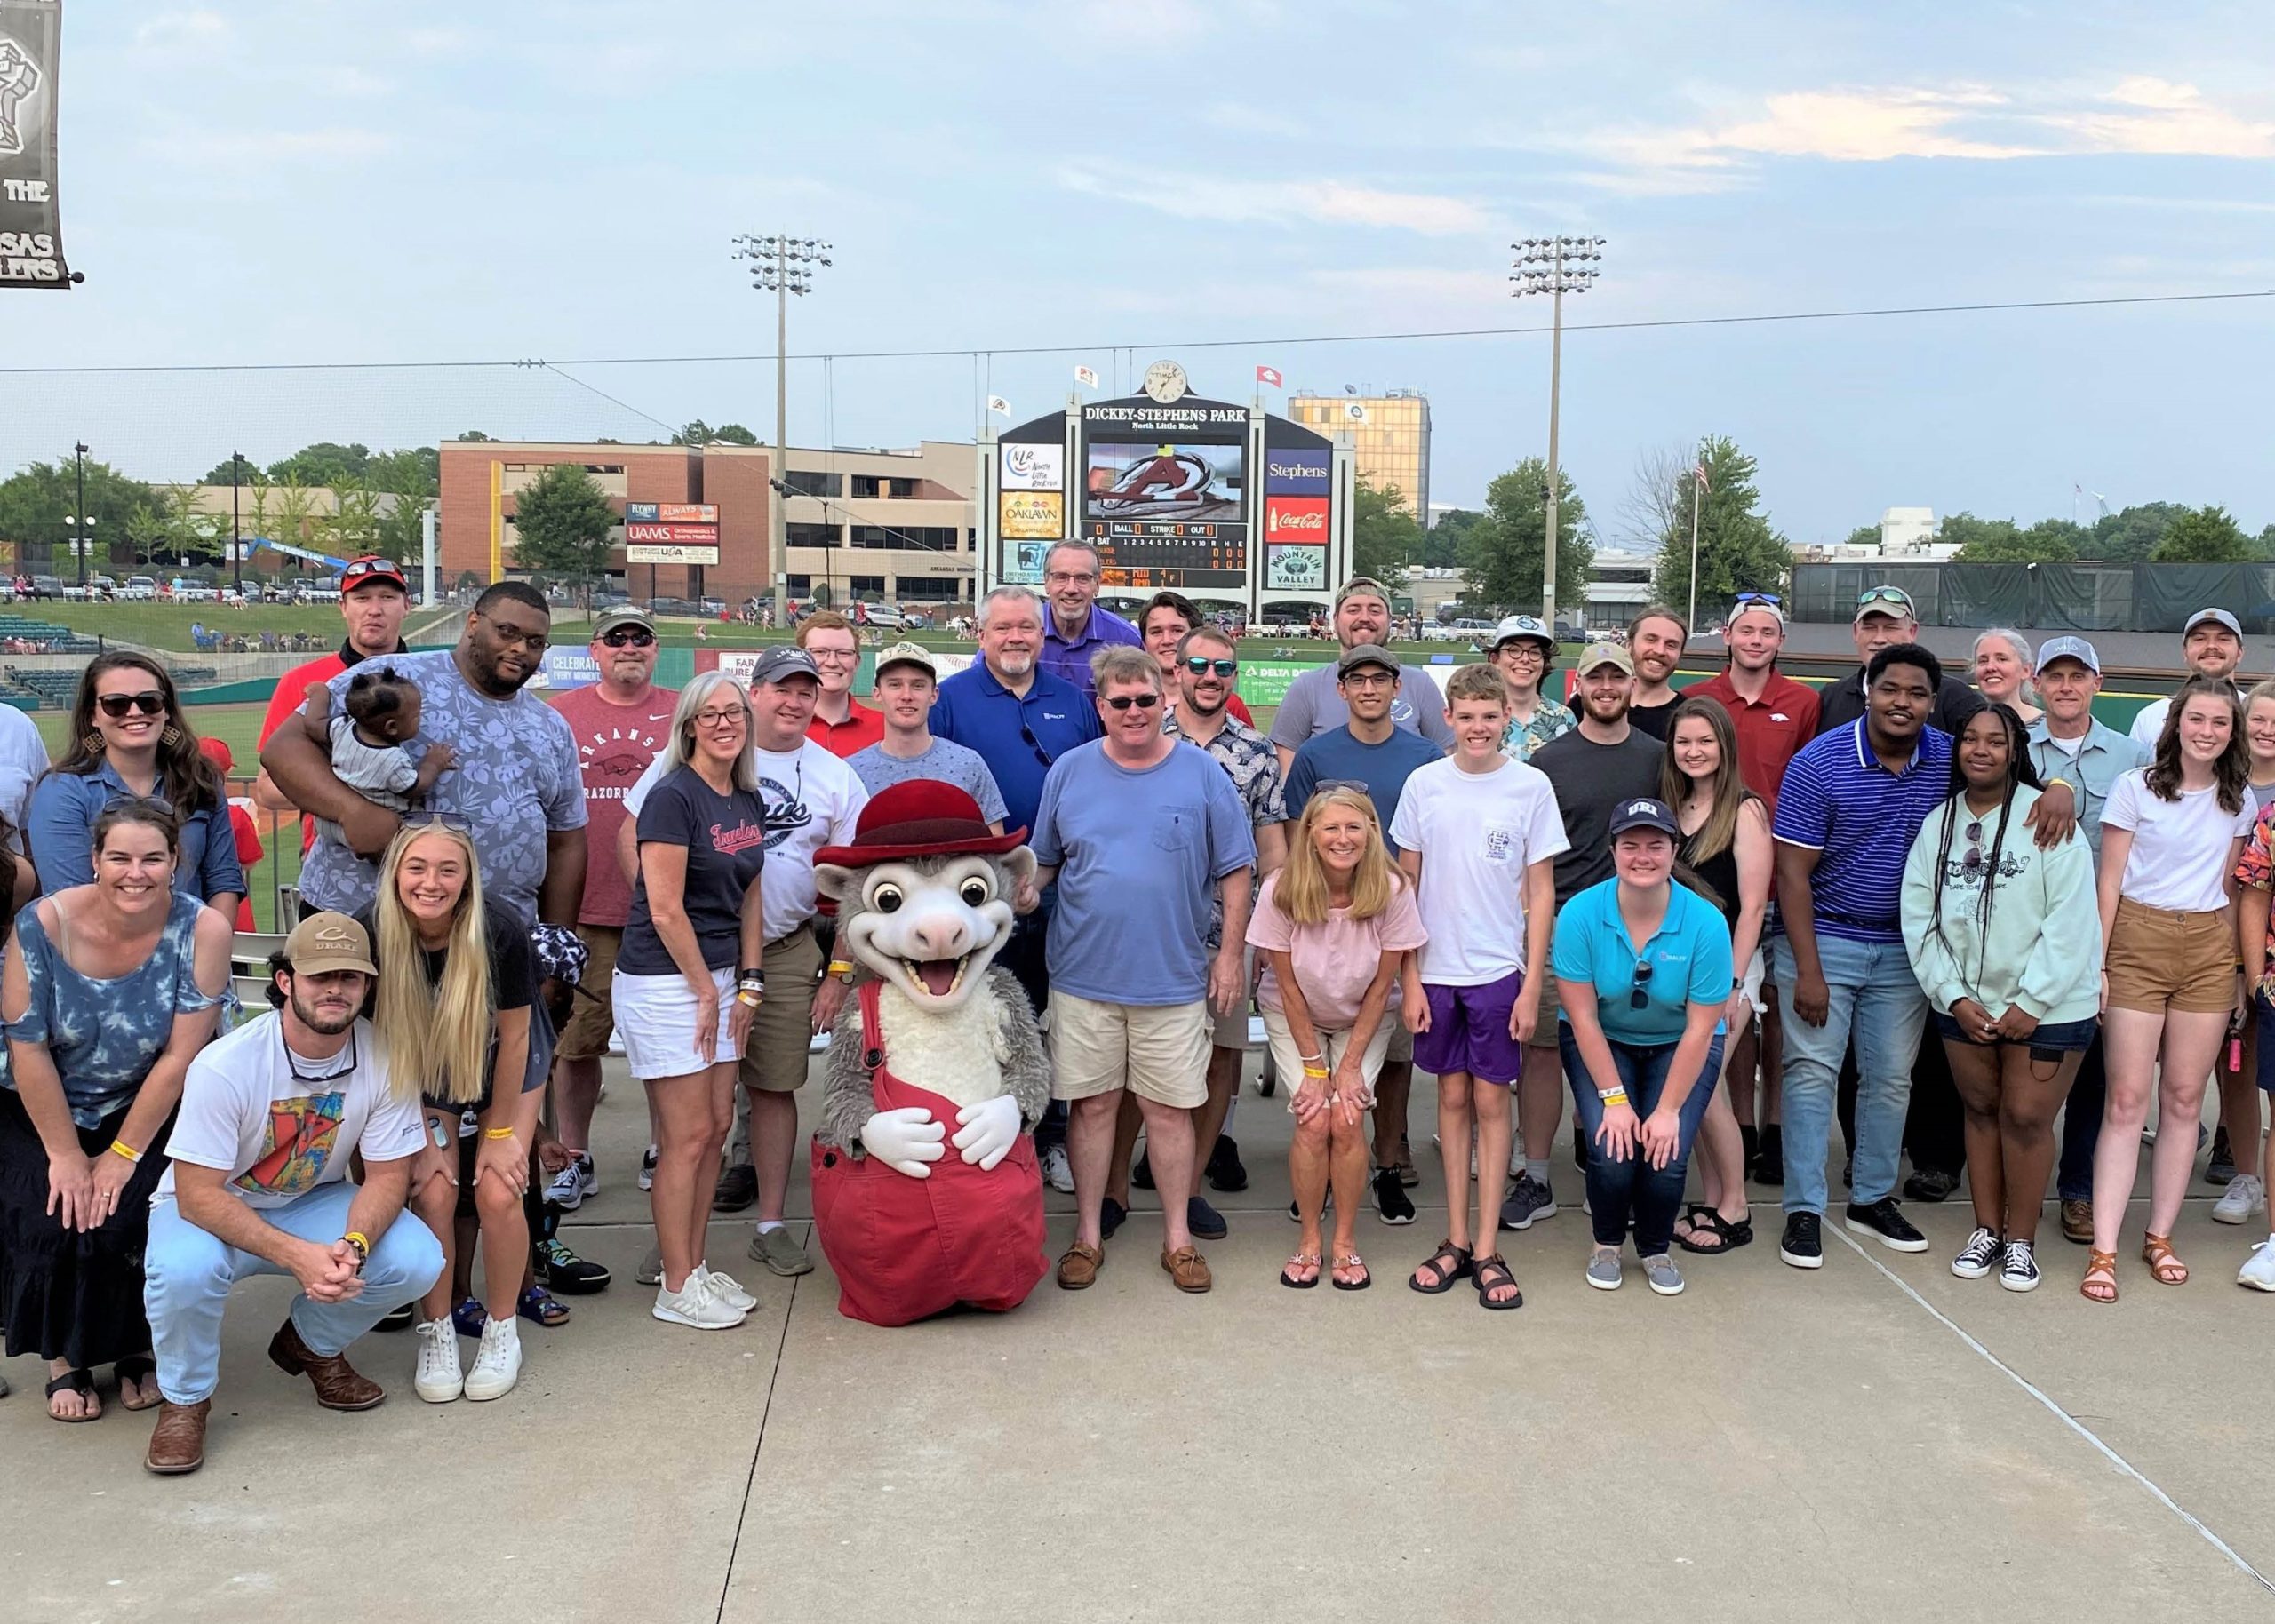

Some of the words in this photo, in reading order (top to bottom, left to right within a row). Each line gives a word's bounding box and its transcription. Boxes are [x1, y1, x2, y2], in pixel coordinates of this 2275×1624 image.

[4, 179, 51, 202] THE
[1085, 408, 1207, 422] DICKEY-STEPHENS
[1209, 410, 1246, 422] PARK
[1270, 464, 1327, 480] Stephens
[662, 506, 697, 516] ALWAYS
[1006, 509, 1057, 519] OAKLAWN
[629, 527, 671, 540] UAMS
[1271, 552, 1322, 569] MOUNTAIN
[736, 658, 754, 667] FAR
[554, 671, 571, 680] EVERY
[1260, 668, 1289, 677] DELTA
[579, 728, 659, 769] ARKANS
[1628, 801, 1659, 817] URI
[315, 943, 358, 952] DRAKE
